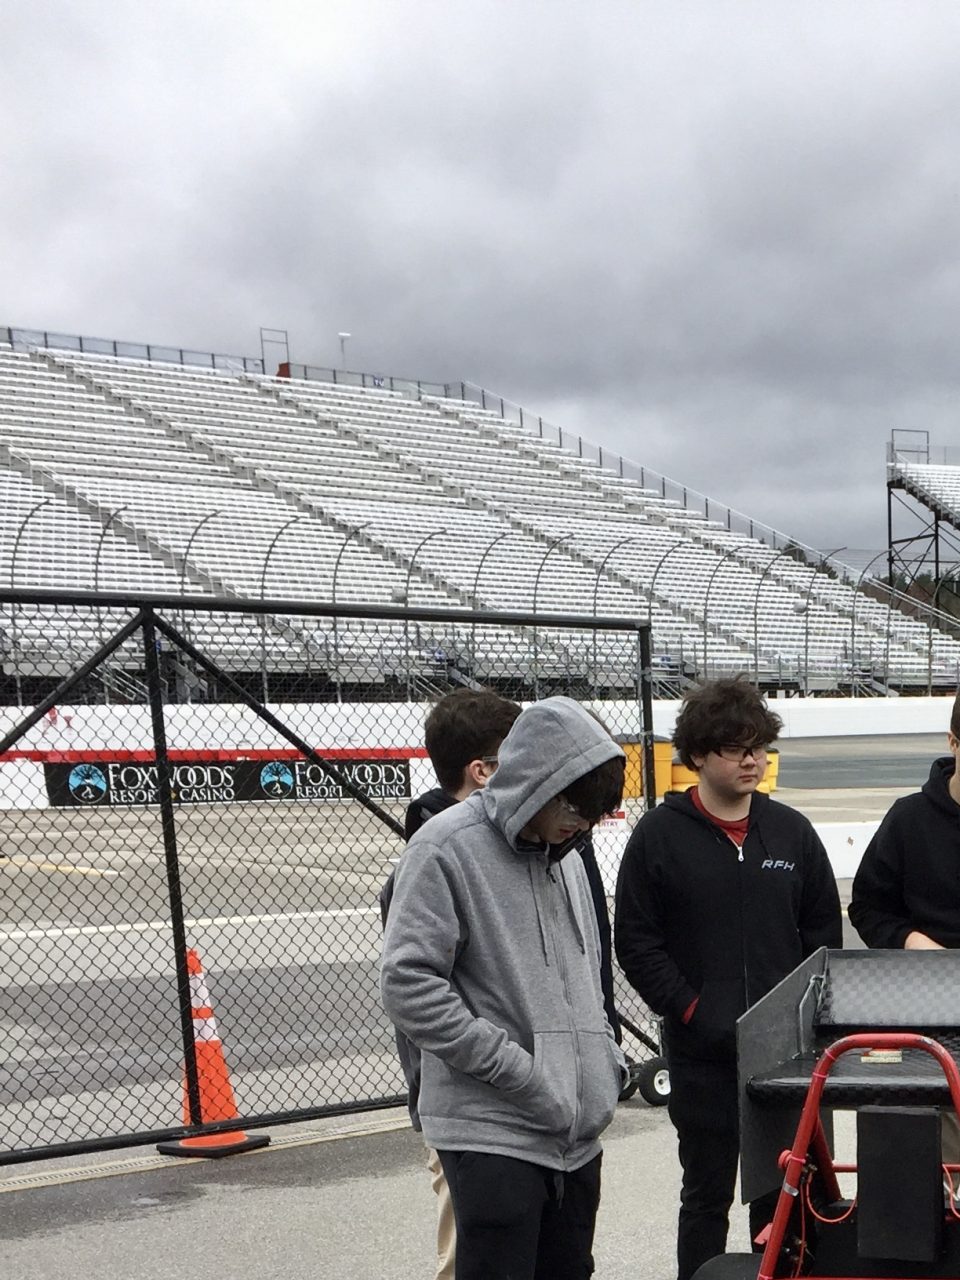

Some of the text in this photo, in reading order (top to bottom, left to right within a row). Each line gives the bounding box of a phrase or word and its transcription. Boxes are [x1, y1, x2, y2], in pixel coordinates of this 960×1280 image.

[110, 787, 235, 804] RESOR CASINO
[296, 784, 405, 799] RESORT ASINO
[761, 859, 795, 871] RFH
